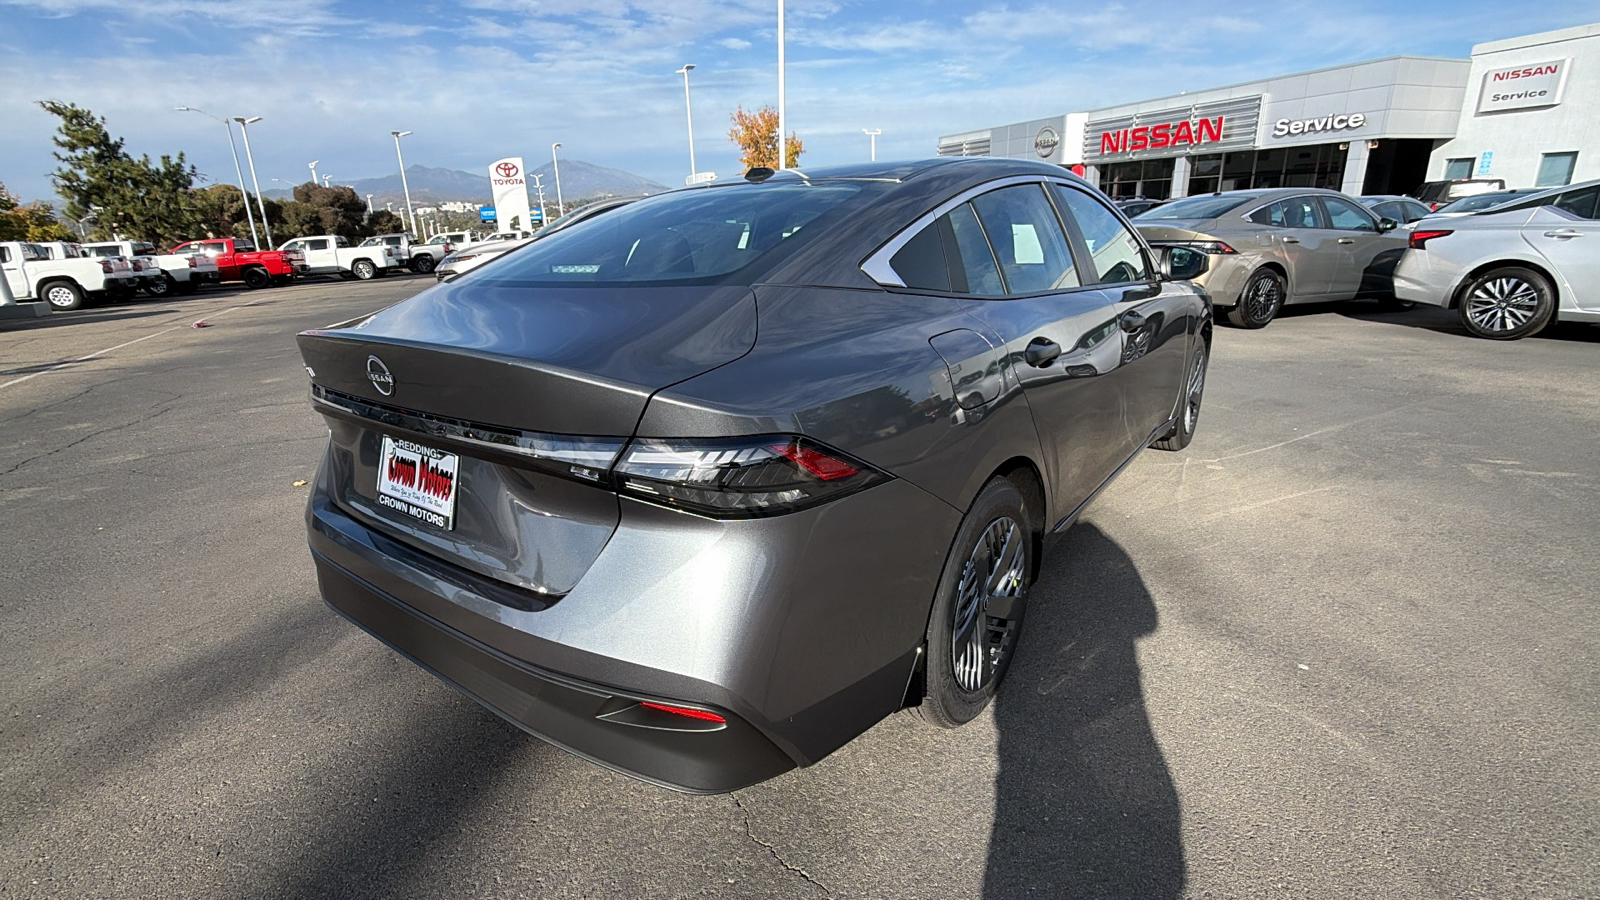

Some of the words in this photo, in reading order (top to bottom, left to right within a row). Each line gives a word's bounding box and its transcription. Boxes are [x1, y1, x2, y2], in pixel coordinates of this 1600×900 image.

[1492, 65, 1558, 82] NISSAN
[1491, 89, 1547, 102] Service
[1100, 116, 1225, 154] NISSAN
[1274, 113, 1364, 136] Service
[399, 440, 437, 458] REDDING
[388, 455, 416, 488] Crown
[418, 455, 453, 501] Motors
[379, 494, 408, 513] CROWN
[409, 506, 444, 527] MOTORS
